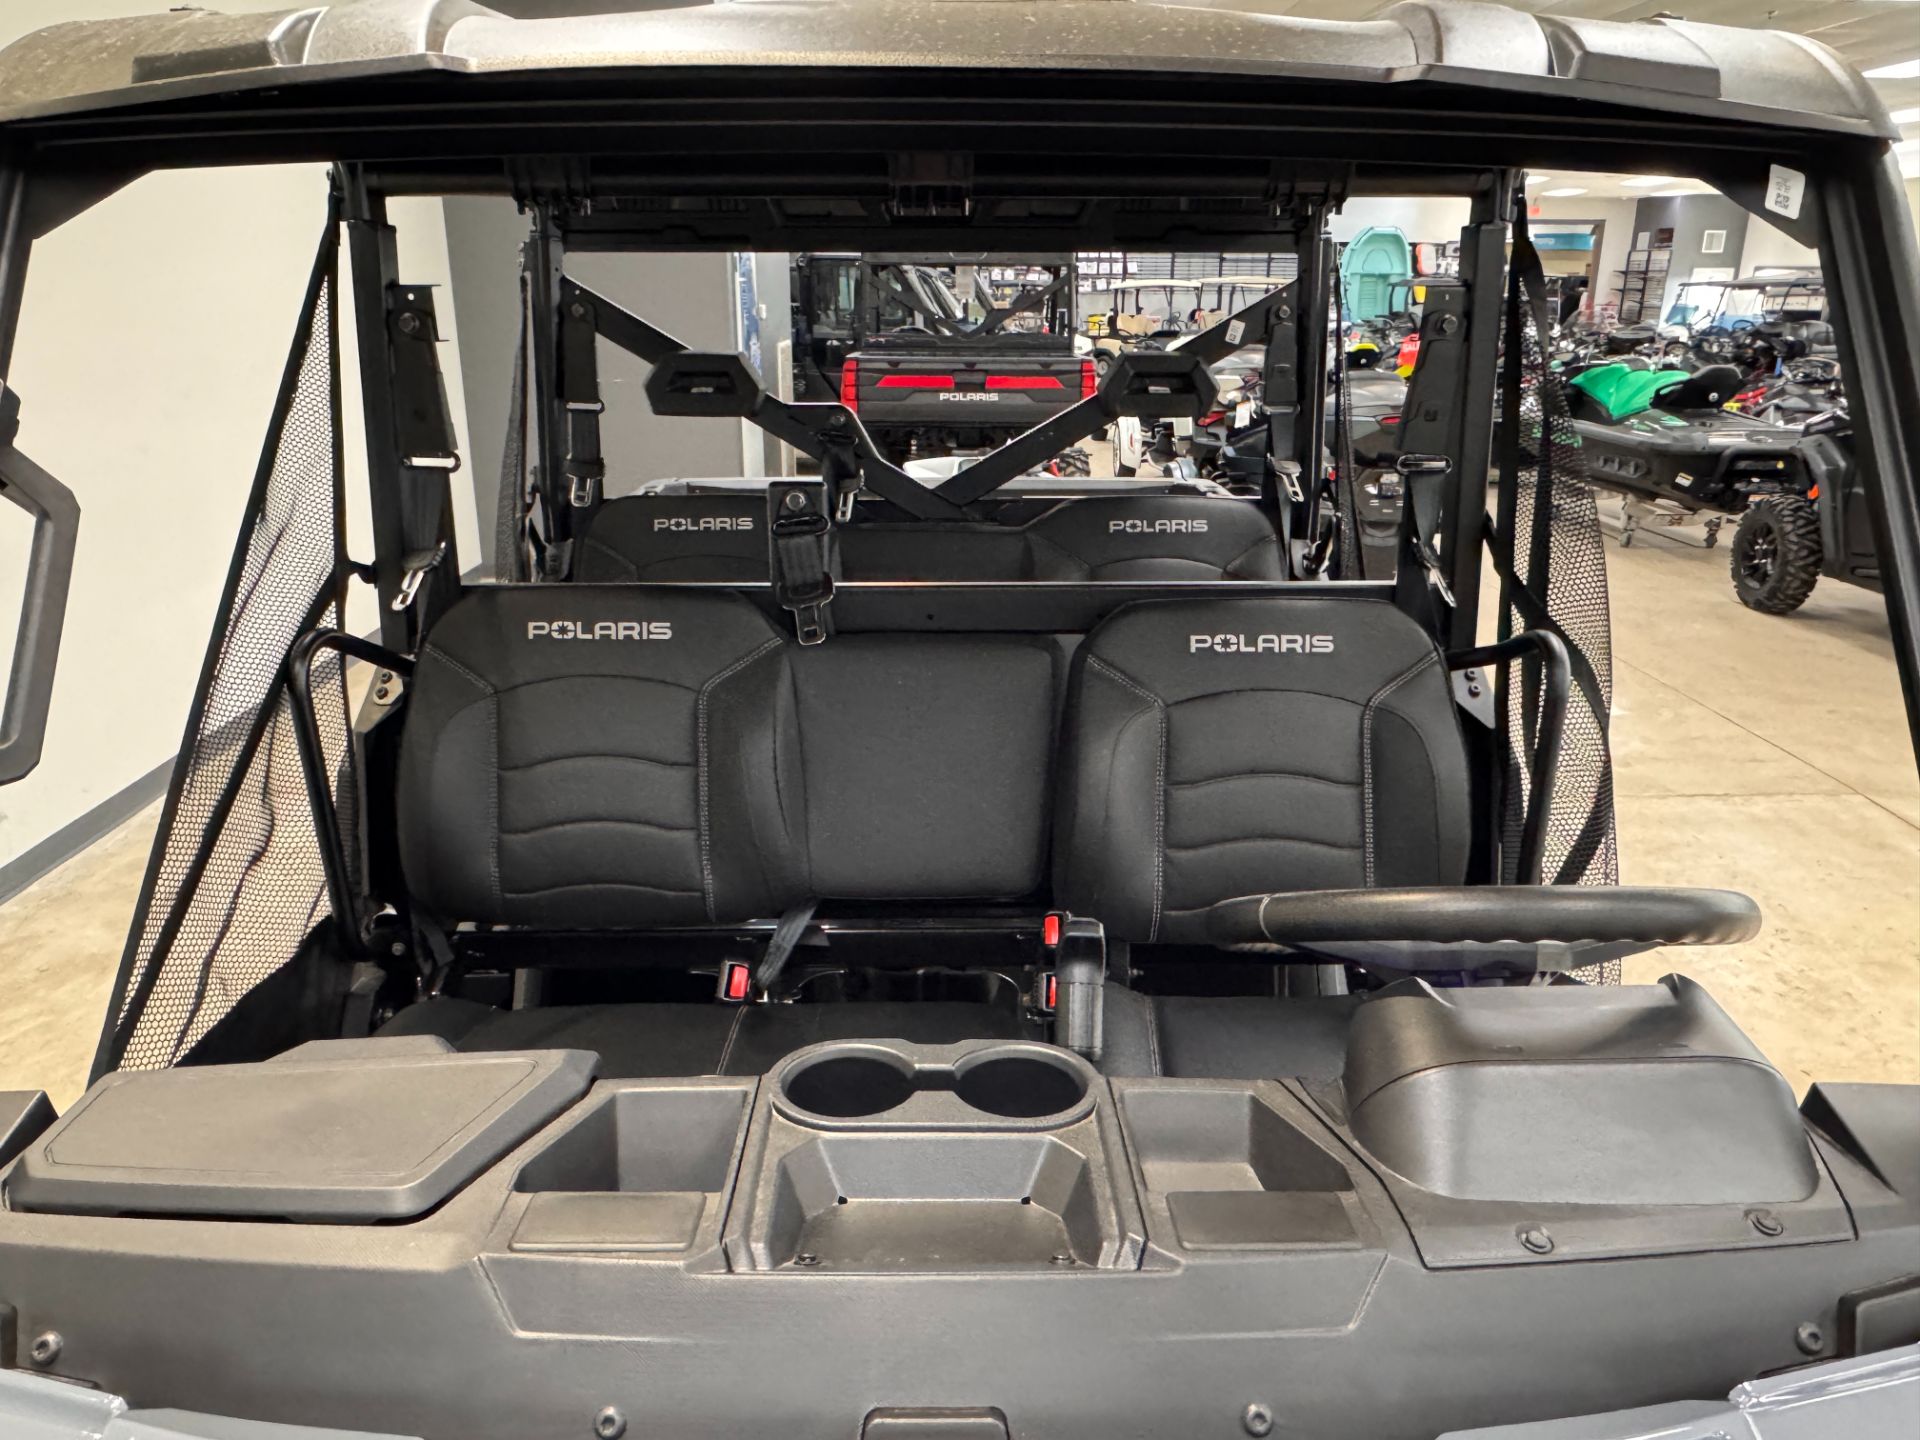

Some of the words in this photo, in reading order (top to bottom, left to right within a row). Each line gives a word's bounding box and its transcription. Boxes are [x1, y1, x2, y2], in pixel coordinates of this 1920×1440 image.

[939, 392, 999, 402] POLARIS
[653, 517, 754, 532] POLARIS
[1108, 519, 1209, 533] POLARIS
[527, 620, 673, 640] POLARIS
[1189, 633, 1335, 654] POLARIS
